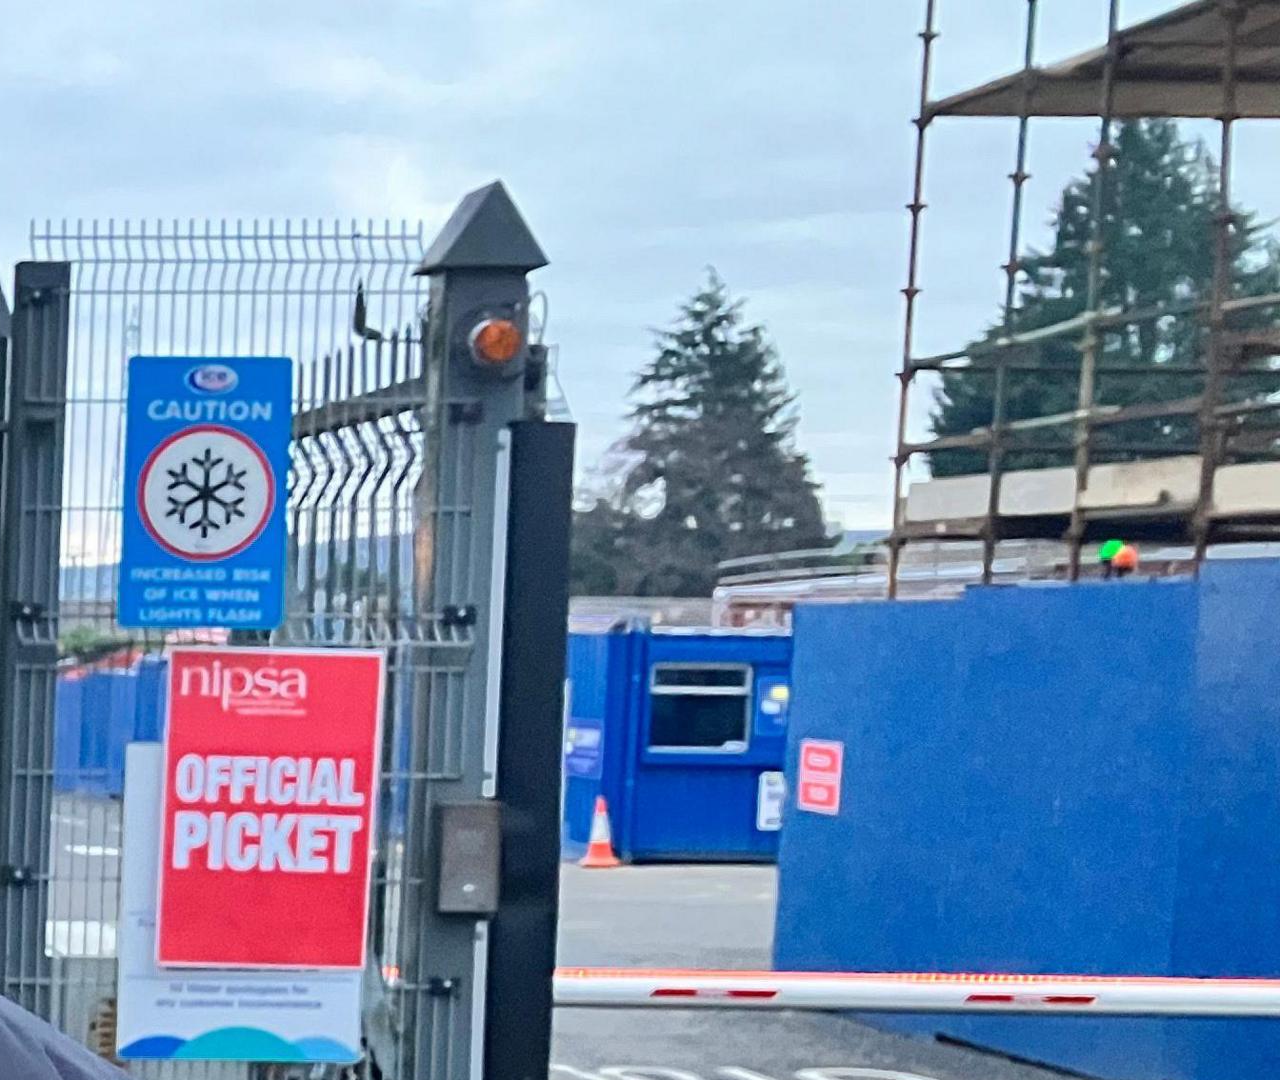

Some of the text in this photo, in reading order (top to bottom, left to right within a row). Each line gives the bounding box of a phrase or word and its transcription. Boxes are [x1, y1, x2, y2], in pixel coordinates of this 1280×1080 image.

[147, 400, 272, 421] CAUTION
[130, 567, 271, 582] INCREASED RISK
[143, 587, 260, 602] OF ICE WHEN
[139, 607, 262, 622] LIGHTS FLASH
[180, 660, 307, 711] nipsa
[175, 753, 364, 806] OFFICIAL
[172, 810, 363, 873] PICKET
